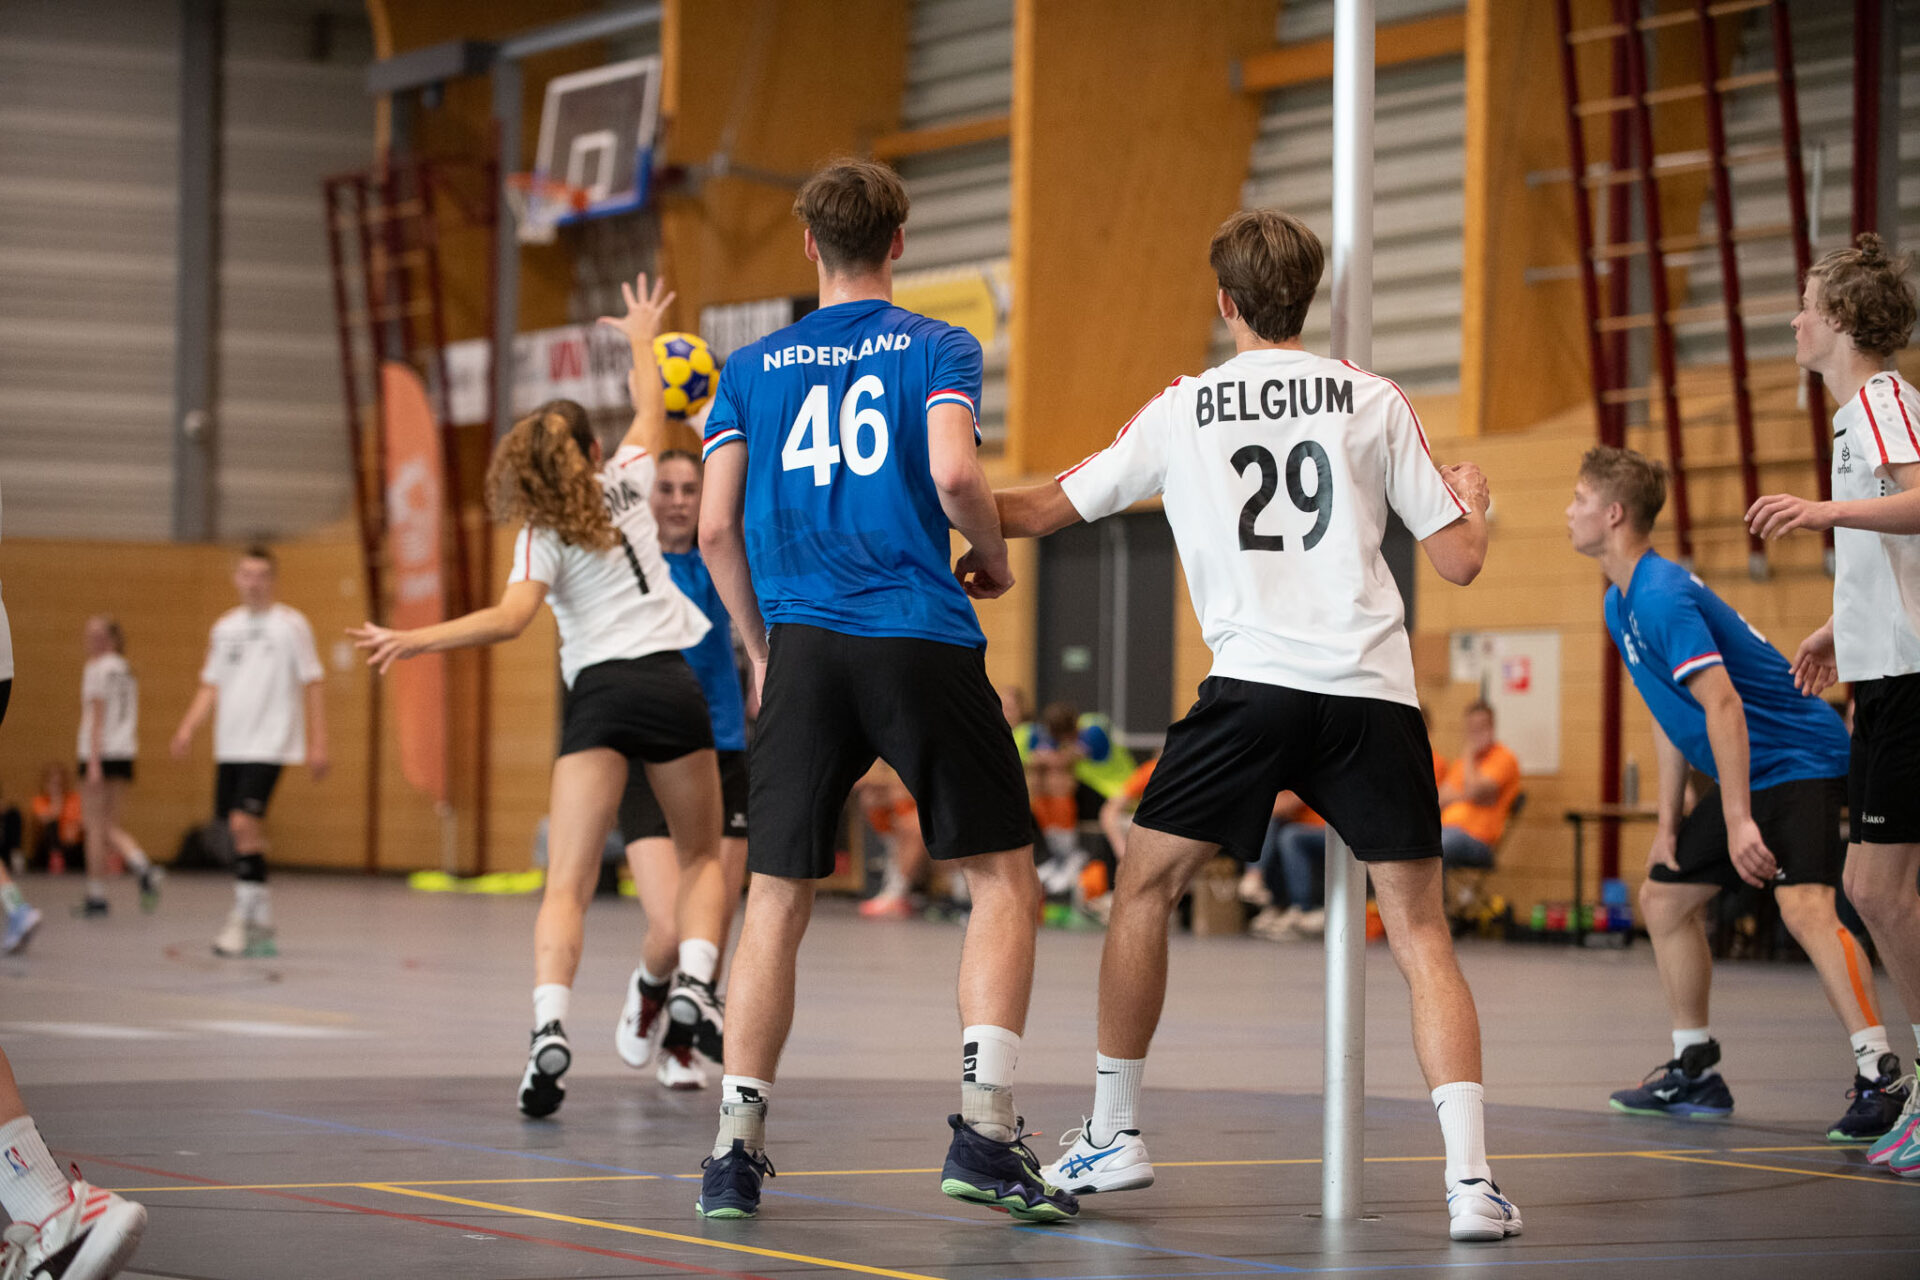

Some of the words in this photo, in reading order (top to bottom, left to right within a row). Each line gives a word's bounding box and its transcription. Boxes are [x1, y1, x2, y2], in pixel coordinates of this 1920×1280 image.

[763, 333, 911, 372] NEDERLAND
[1196, 377, 1354, 428] BELGIUM
[781, 374, 889, 487] 46
[1230, 440, 1333, 552] 29
[1866, 815, 1885, 824] JAKO
